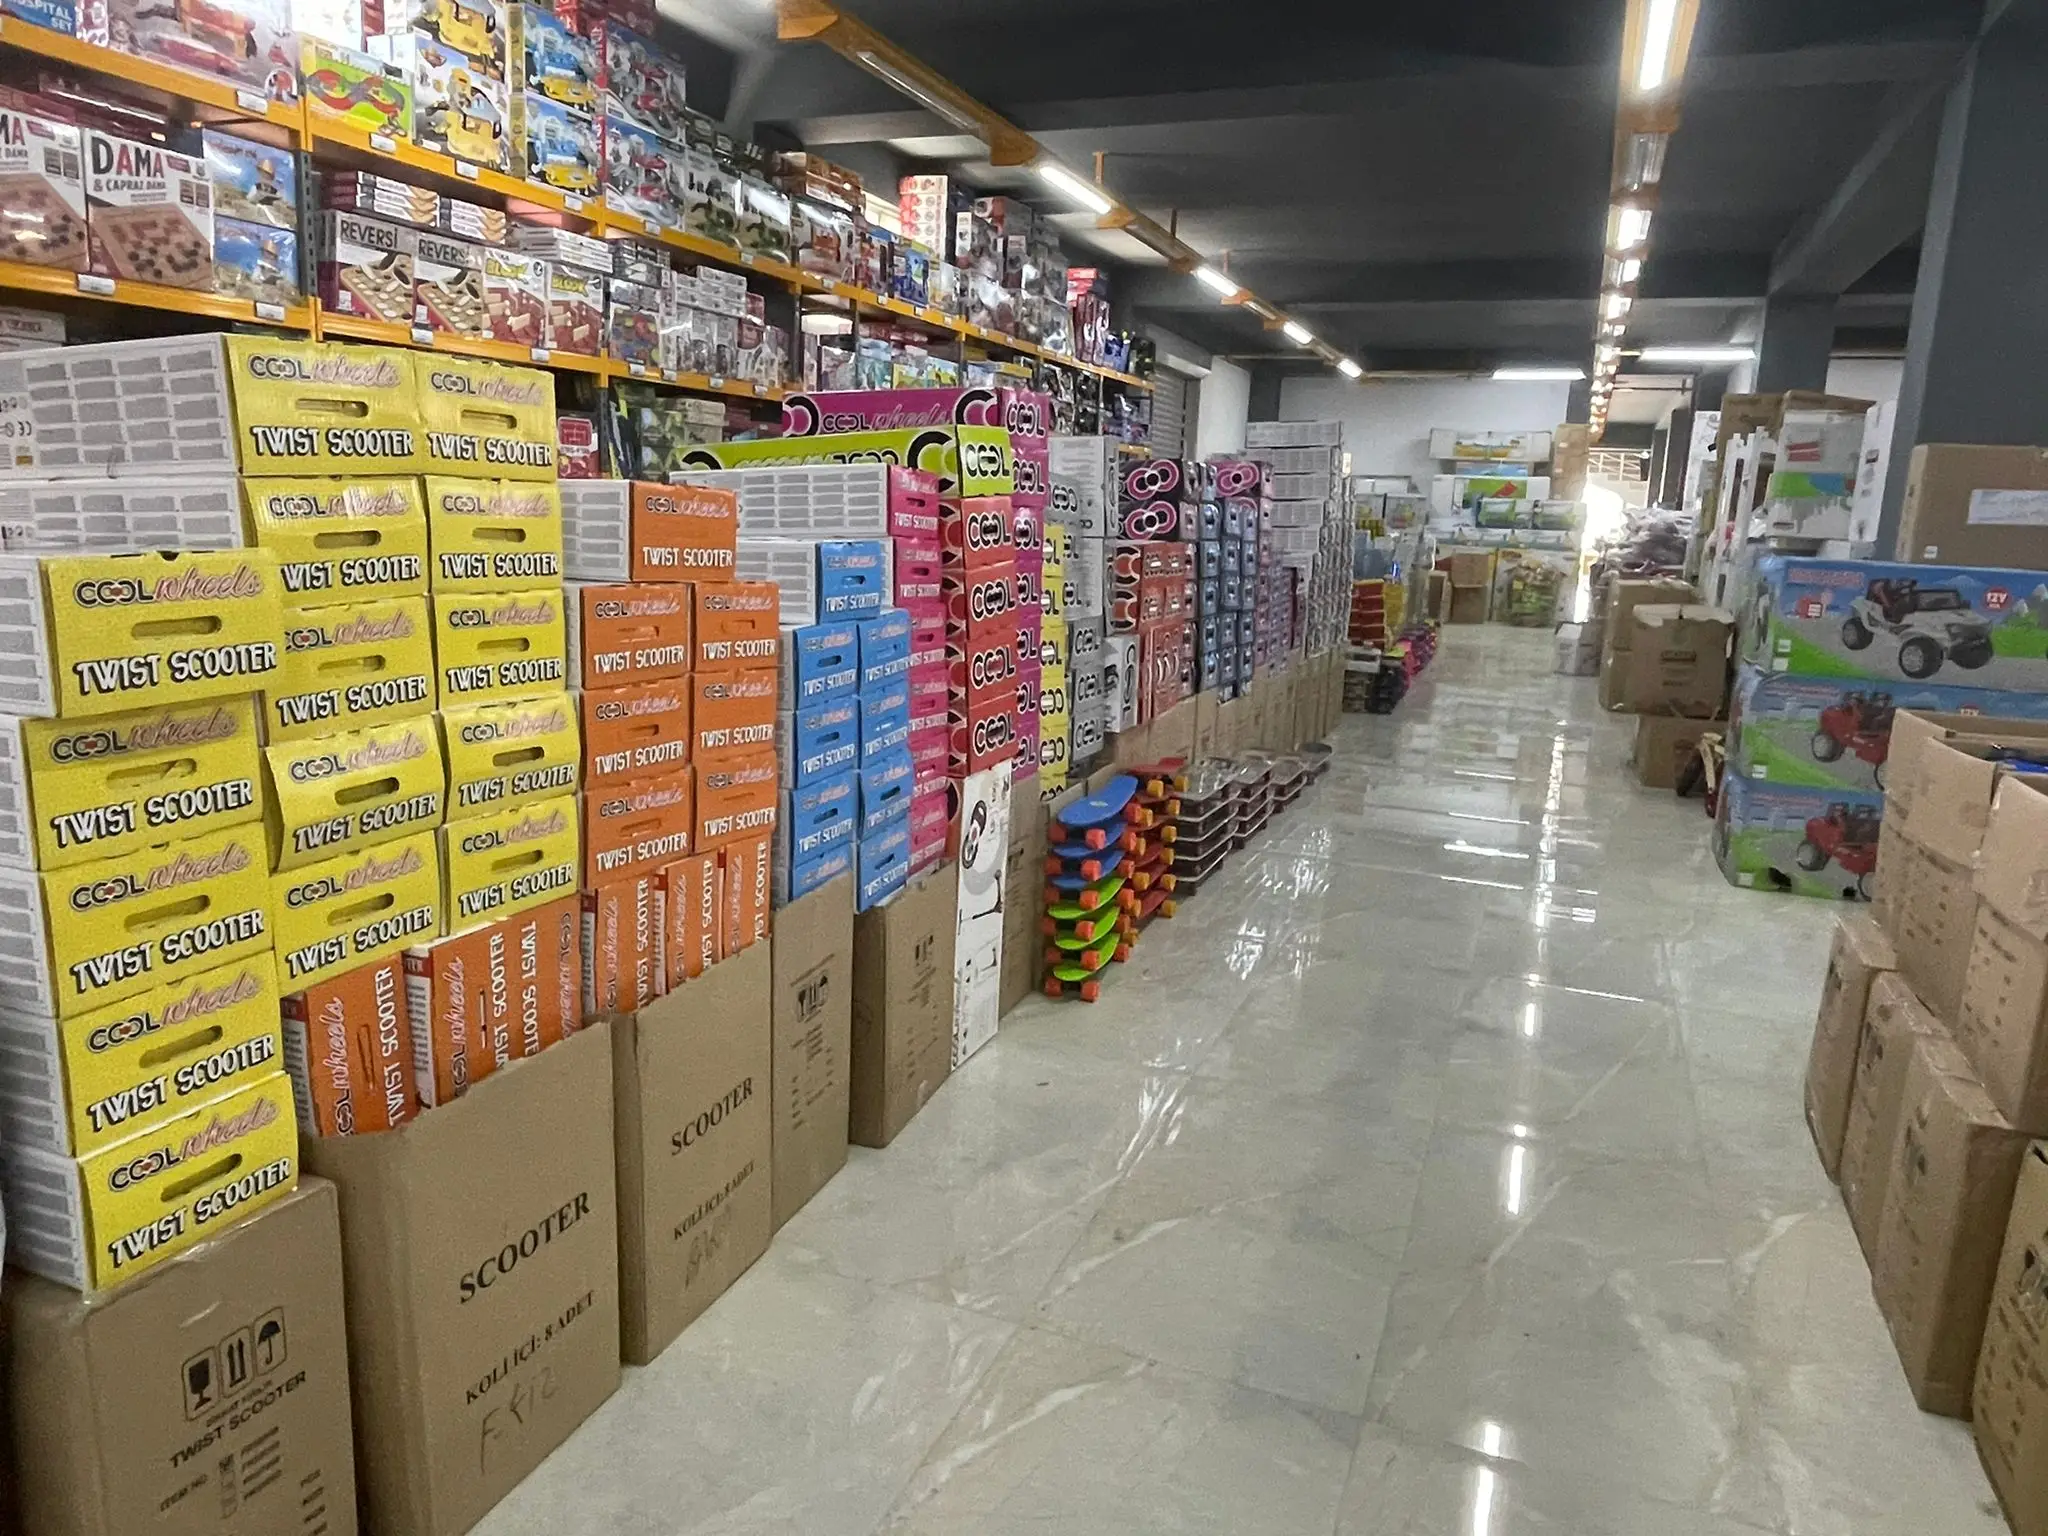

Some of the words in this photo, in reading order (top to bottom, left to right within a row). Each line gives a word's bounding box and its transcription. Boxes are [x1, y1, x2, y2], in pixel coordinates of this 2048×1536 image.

[51, 18, 73, 32] SET
[91, 136, 164, 178] DAMA
[250, 426, 319, 456] TWIST
[328, 429, 414, 457] SCOOTER
[428, 432, 479, 460] TWIST
[486, 438, 552, 466] SCOOTER
[281, 561, 334, 591] WIST
[341, 555, 421, 585] SCOOTER
[441, 553, 491, 579] TWIST
[495, 552, 558, 577] SCOOTER
[643, 546, 679, 566] TWIST
[684, 548, 733, 568] SCOOTER
[74, 579, 154, 607] COOL
[74, 654, 161, 696] TWIST
[168, 642, 277, 683] SCOOTER
[594, 652, 630, 674] TWIST
[636, 645, 684, 668] SCOOTER
[703, 640, 731, 660] TWIST
[735, 639, 776, 659] SCOOTER
[447, 665, 496, 692] TWIST
[500, 657, 562, 685] SCOOTER
[277, 689, 340, 727] TWIST
[348, 675, 428, 711] SCOOTER
[51, 731, 128, 763] COOL
[594, 749, 632, 776] TWIST
[636, 740, 684, 767] SCOOTER
[701, 728, 731, 750] TWIST
[734, 724, 774, 744] SCOOTER
[459, 777, 506, 808] TWIST
[513, 764, 575, 794] SCOOTER
[51, 802, 136, 849] TWIST
[146, 779, 253, 826] SCOOTER
[293, 815, 355, 853] TWIST
[360, 795, 436, 834] SCOOTER
[704, 815, 733, 837] TWIST
[736, 807, 776, 831] SCOOTER
[596, 845, 633, 872] TWIST
[637, 832, 687, 861] SCOOTER
[70, 875, 144, 910] COOL
[459, 883, 506, 917] TWIST
[512, 863, 573, 900] SCOOTER
[637, 878, 649, 952] SCOOTER
[70, 943, 153, 994] TWIST
[160, 909, 264, 964] SCOOTER
[286, 936, 348, 978] TWIST
[356, 906, 433, 952] SCOOTER
[521, 921, 537, 980] TWIST
[490, 932, 508, 1018] SCOOTER
[87, 1013, 161, 1053] COOL
[375, 966, 399, 1057] SCOOTER
[522, 985, 540, 1056] SCOOTE
[494, 1023, 509, 1070] WIST
[86, 1074, 168, 1132] TWIST
[175, 1034, 276, 1095] SCOOTER
[384, 1062, 405, 1127] TWIST
[671, 1077, 753, 1156] SCOOTER
[109, 1148, 182, 1191] COOL
[108, 1205, 187, 1268] TWIST
[195, 1157, 291, 1224] SCOOTER
[459, 1191, 591, 1305] SCOOTER
[169, 1425, 224, 1468] TWIST
[229, 1371, 306, 1430] SCOOTER
